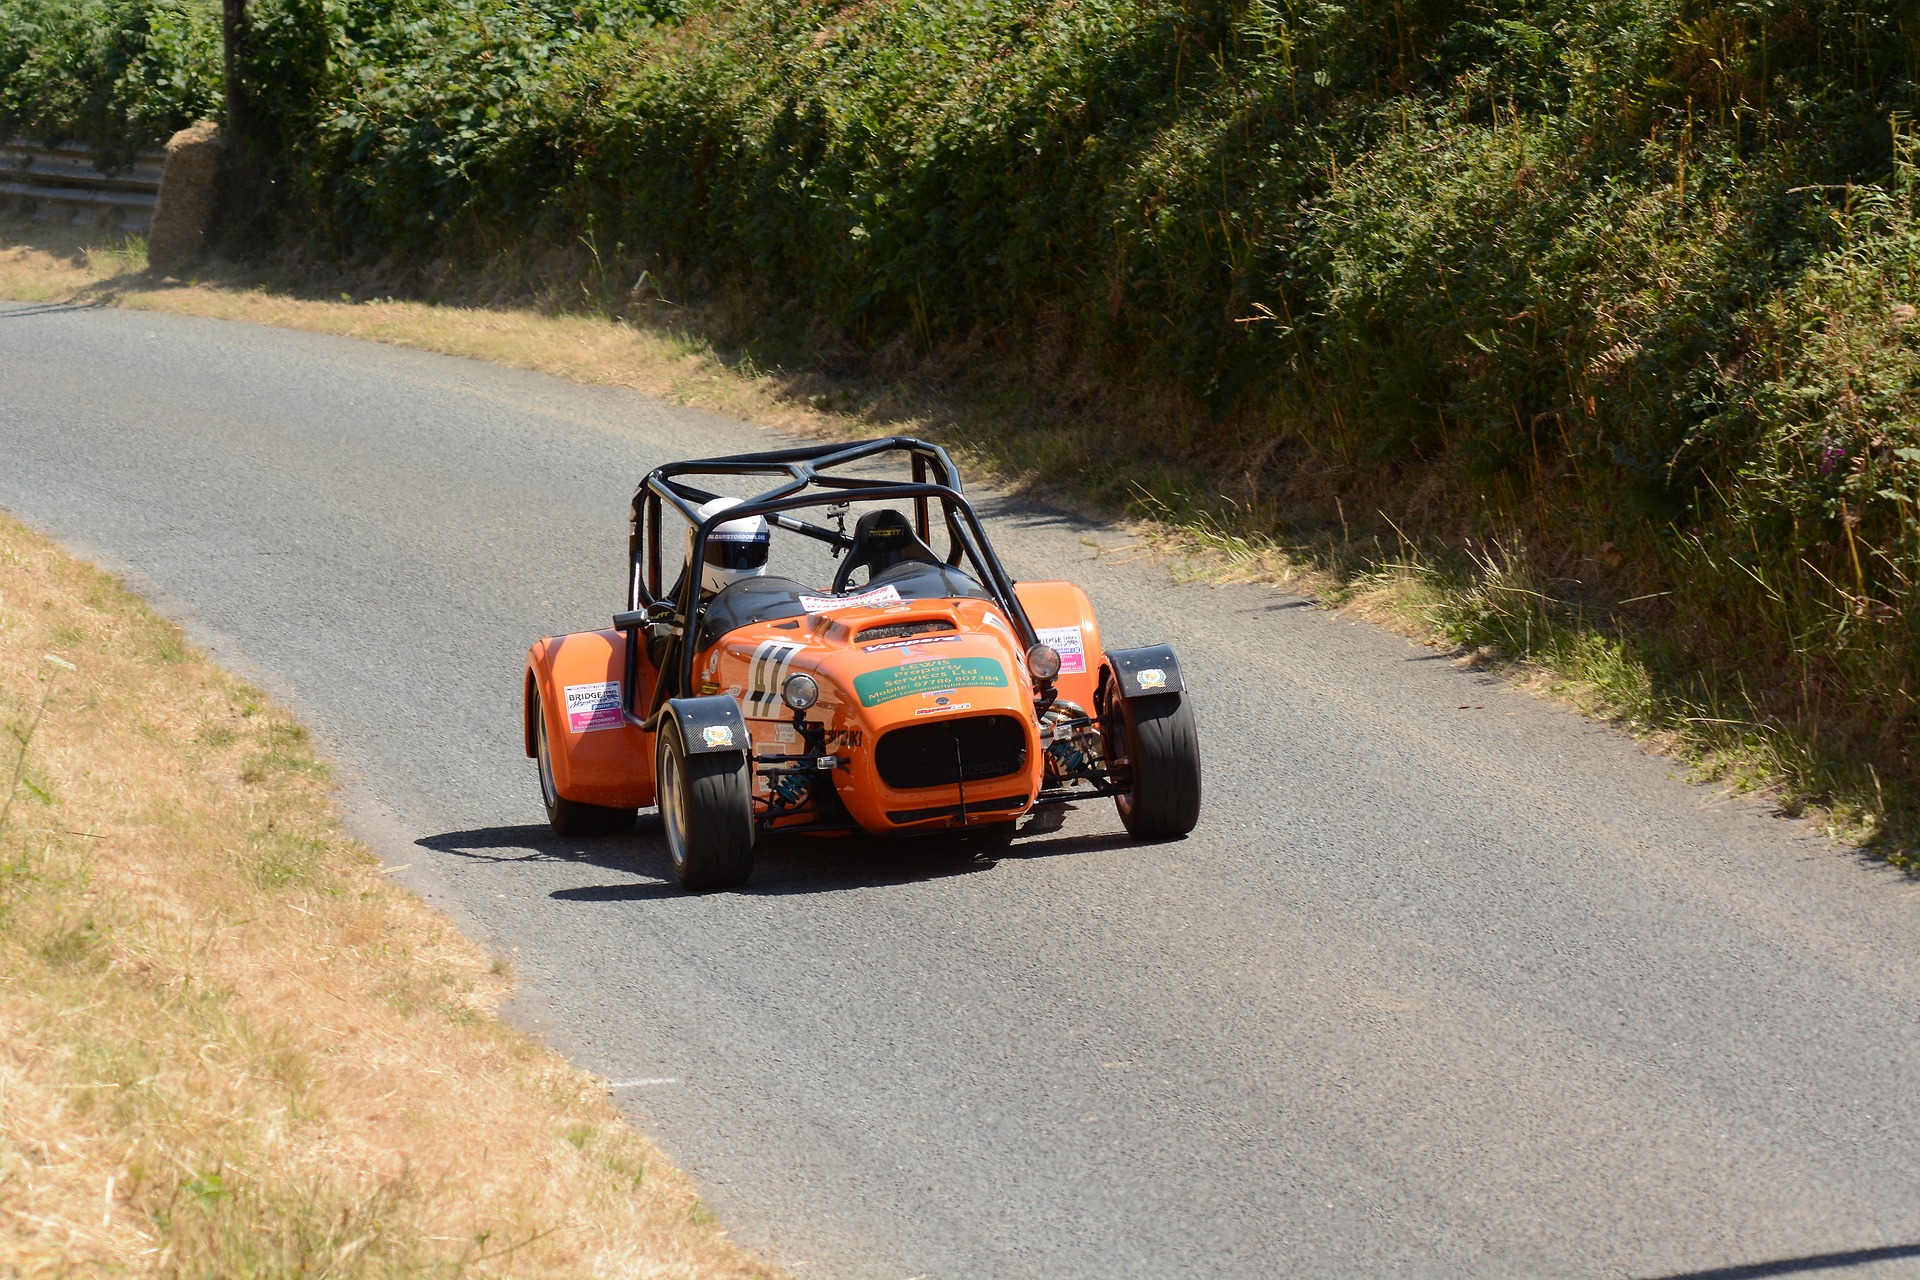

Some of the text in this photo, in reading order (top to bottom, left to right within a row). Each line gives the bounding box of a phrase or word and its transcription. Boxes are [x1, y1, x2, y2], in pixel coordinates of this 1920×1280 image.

[866, 636, 955, 651] Vospers
[894, 665, 961, 678] Property
[900, 660, 950, 671] LEWIS
[884, 672, 947, 686] Services
[569, 692, 602, 701] BRIDGE
[868, 685, 911, 699] Mobile:
